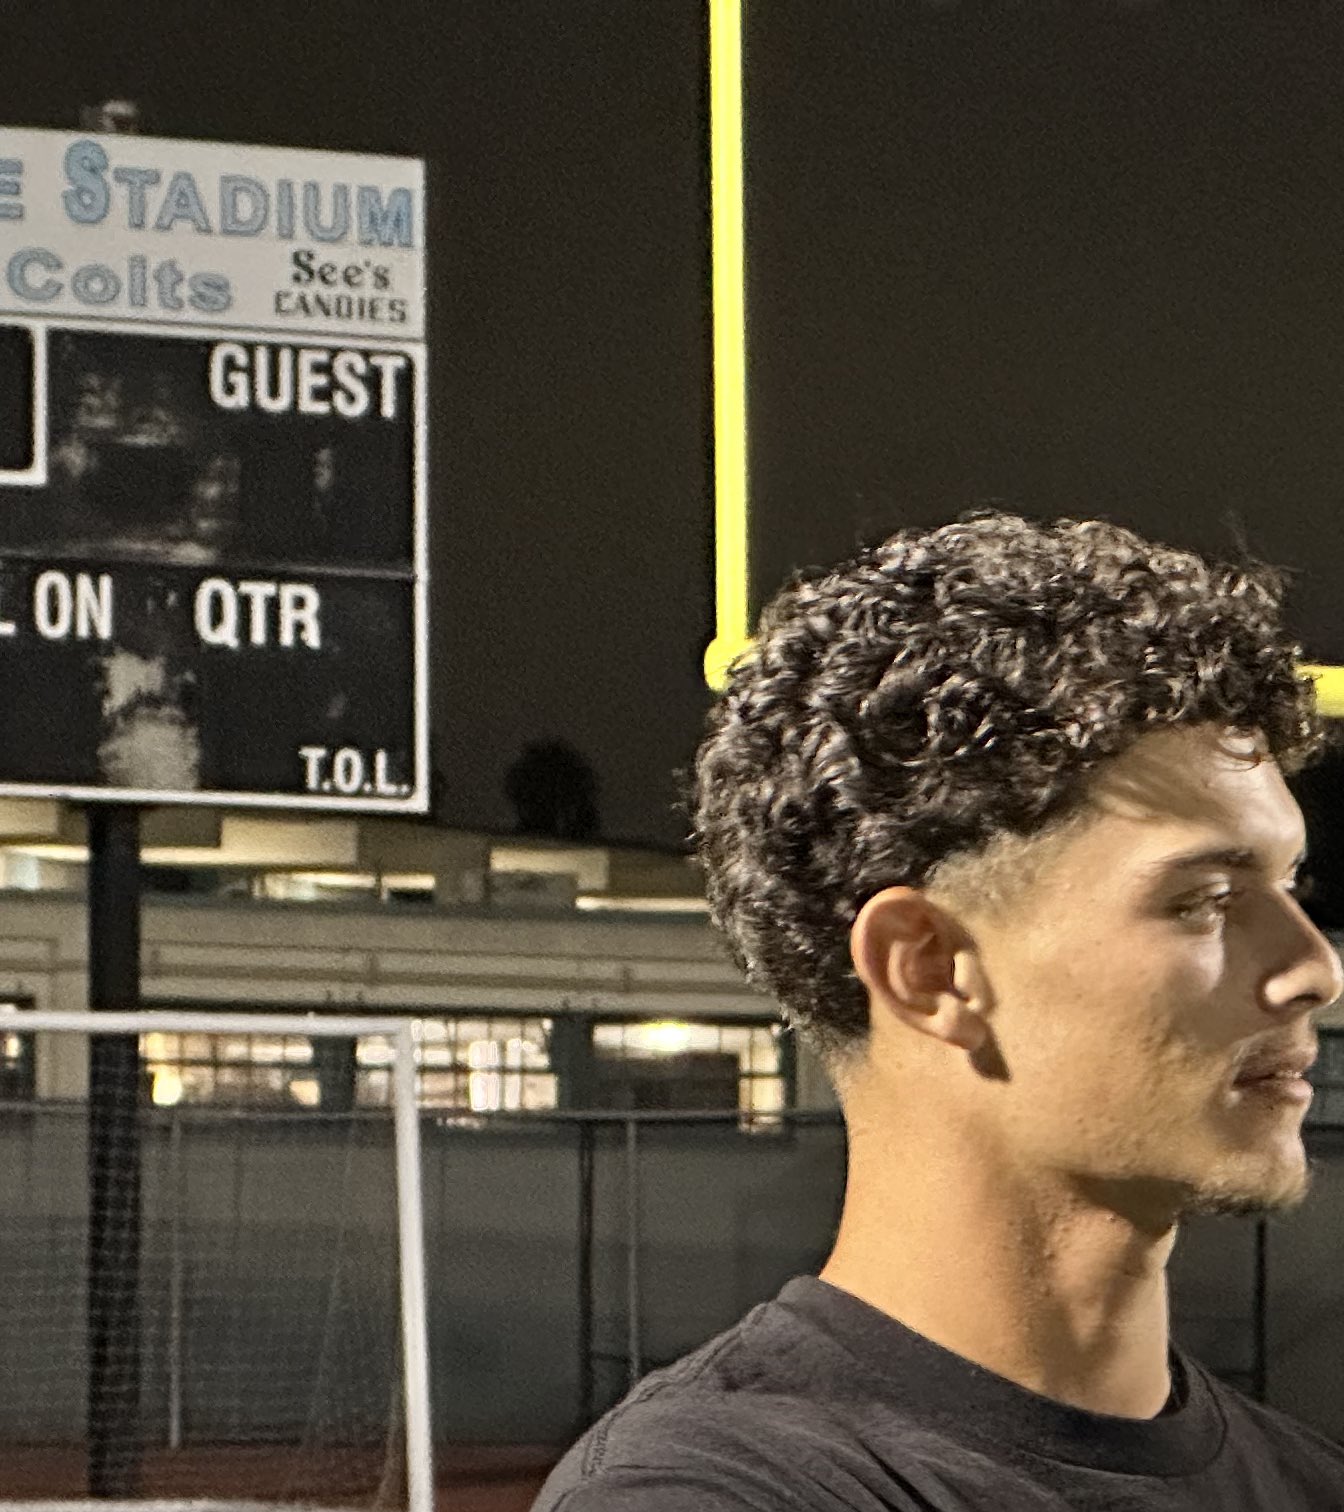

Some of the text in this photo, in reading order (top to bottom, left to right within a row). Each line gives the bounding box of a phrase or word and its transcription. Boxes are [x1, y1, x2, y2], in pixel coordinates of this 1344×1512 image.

[62, 139, 414, 248] STADIUM
[7, 247, 233, 313] Colts
[292, 249, 391, 290] See's
[275, 290, 407, 323] CANDIES
[209, 342, 405, 419] GUEST
[34, 570, 321, 649] ON QTR
[299, 746, 411, 794] T.O.L.
